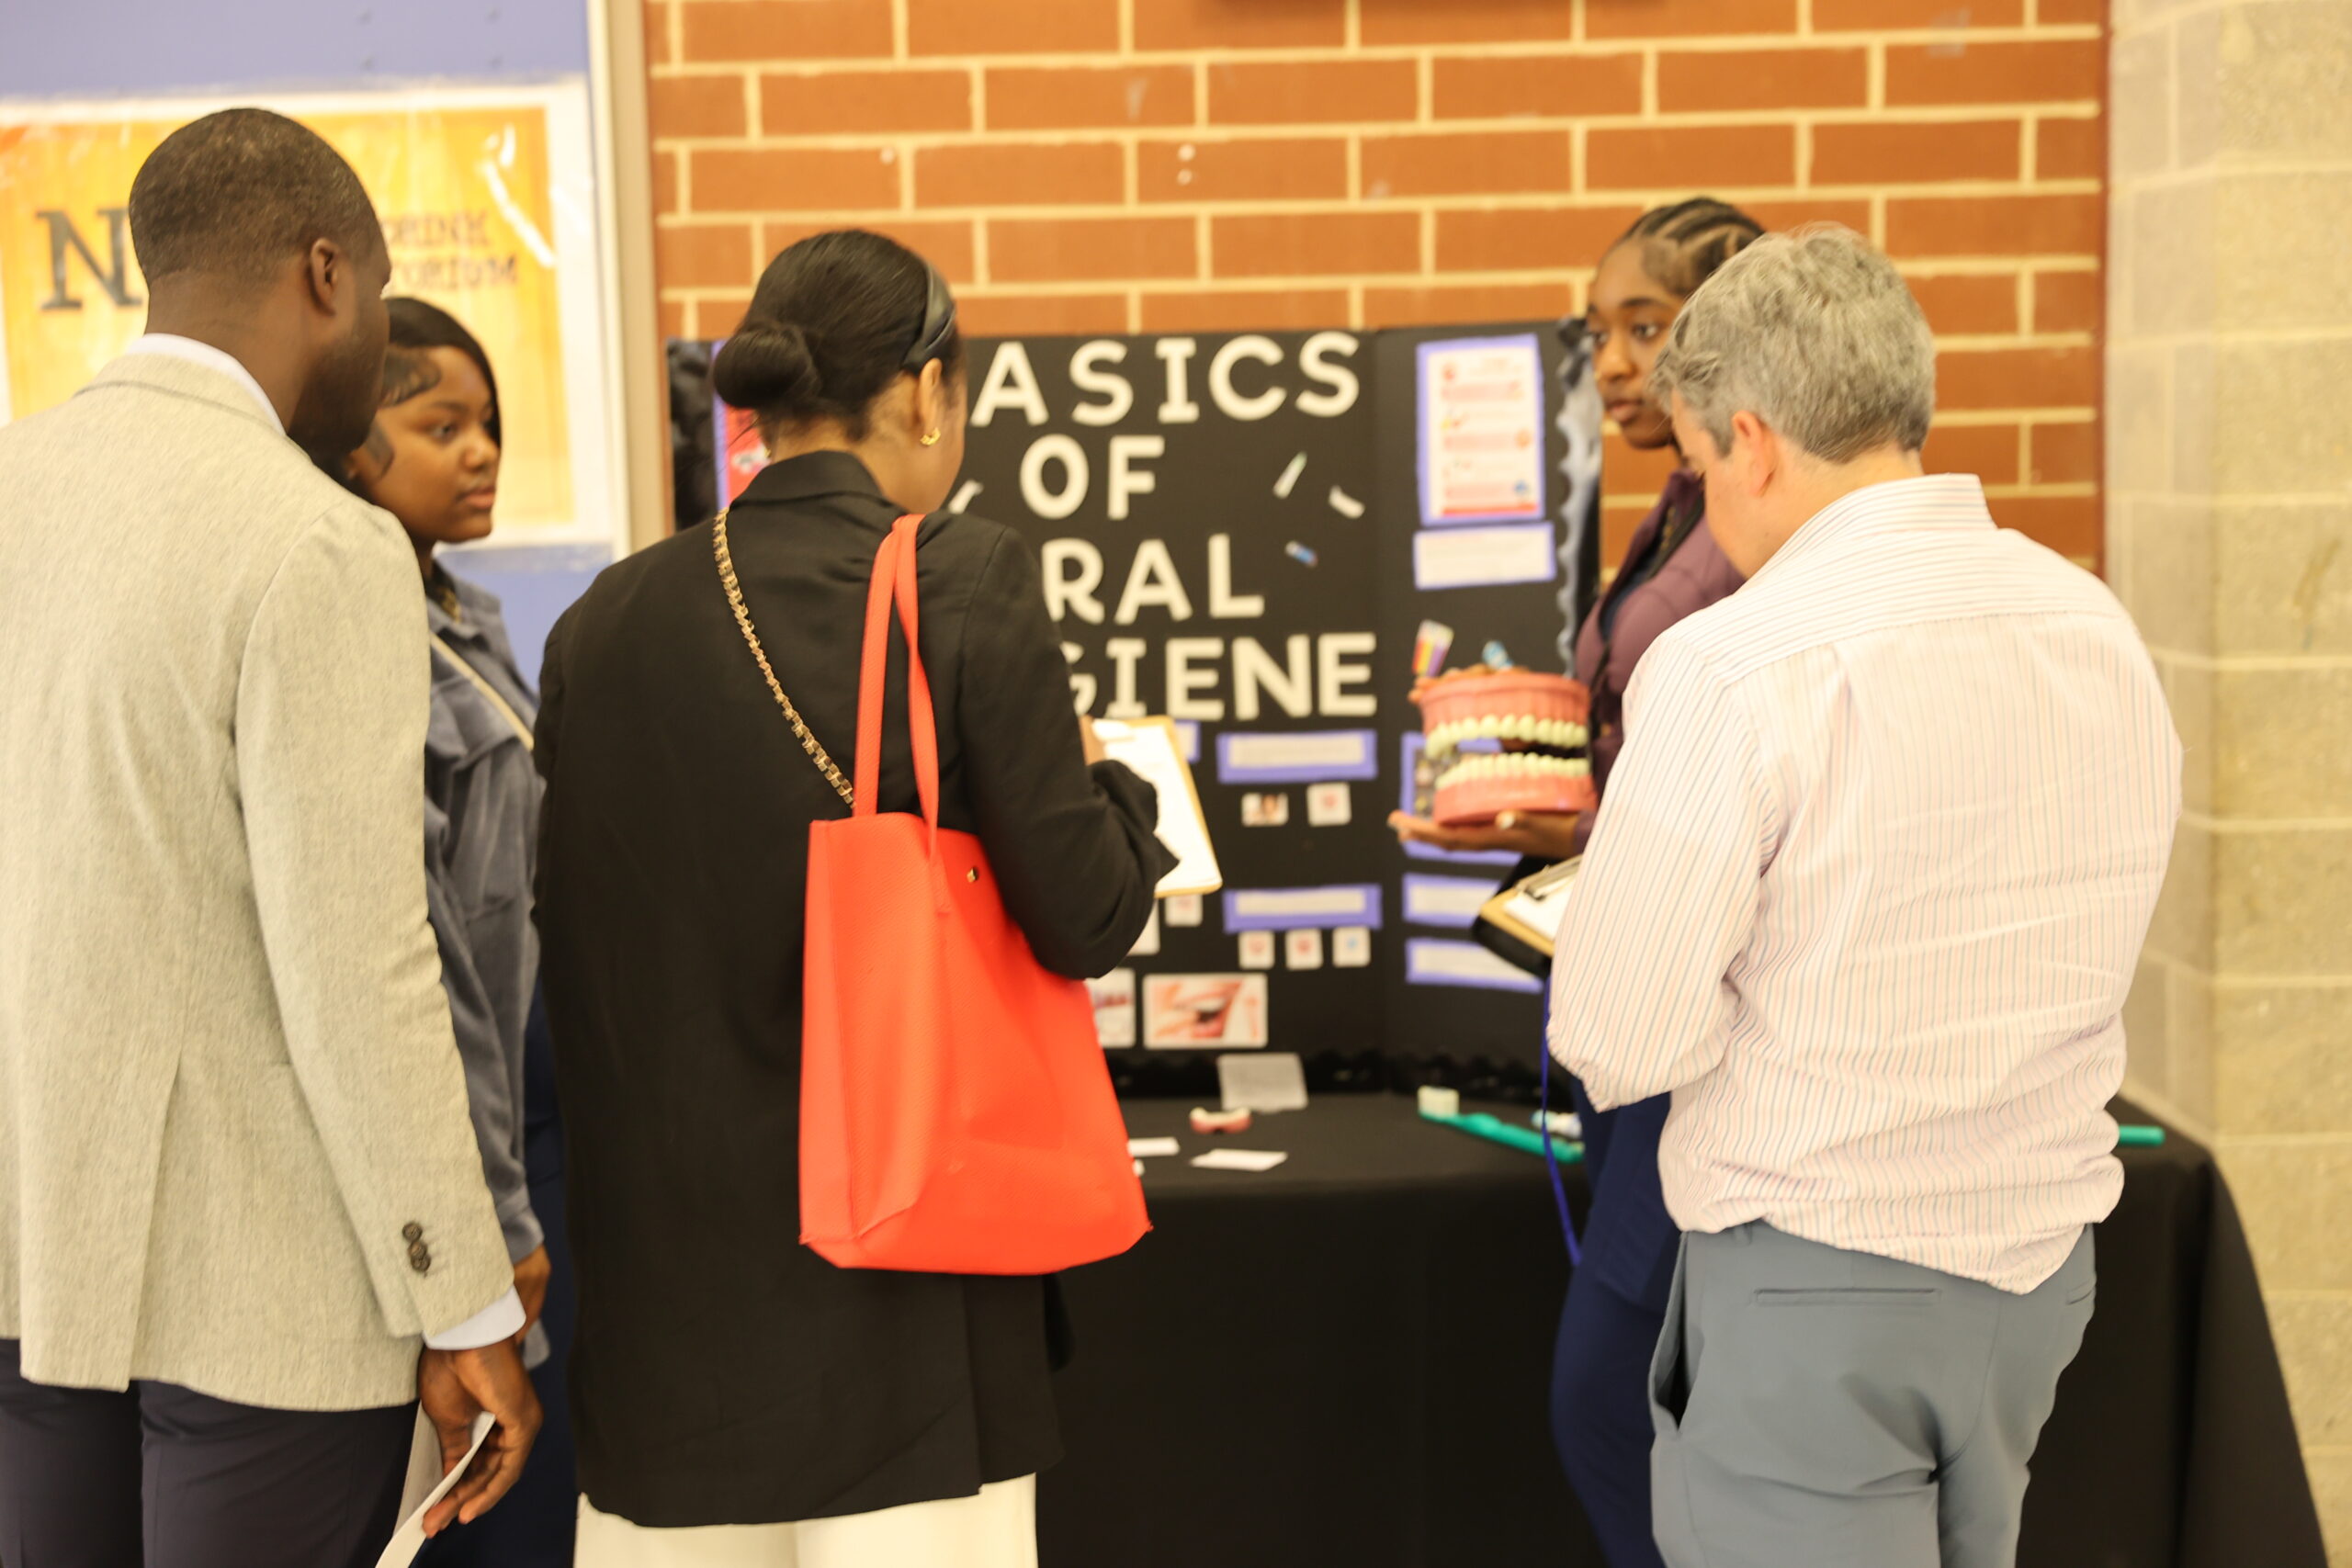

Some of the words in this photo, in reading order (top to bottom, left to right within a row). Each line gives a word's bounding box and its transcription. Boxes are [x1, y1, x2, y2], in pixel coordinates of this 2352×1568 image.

[392, 251, 519, 291] ORIUM
[970, 331, 1360, 427] ASICS
[1019, 434, 1165, 520] OF
[1041, 533, 1265, 625] RAL
